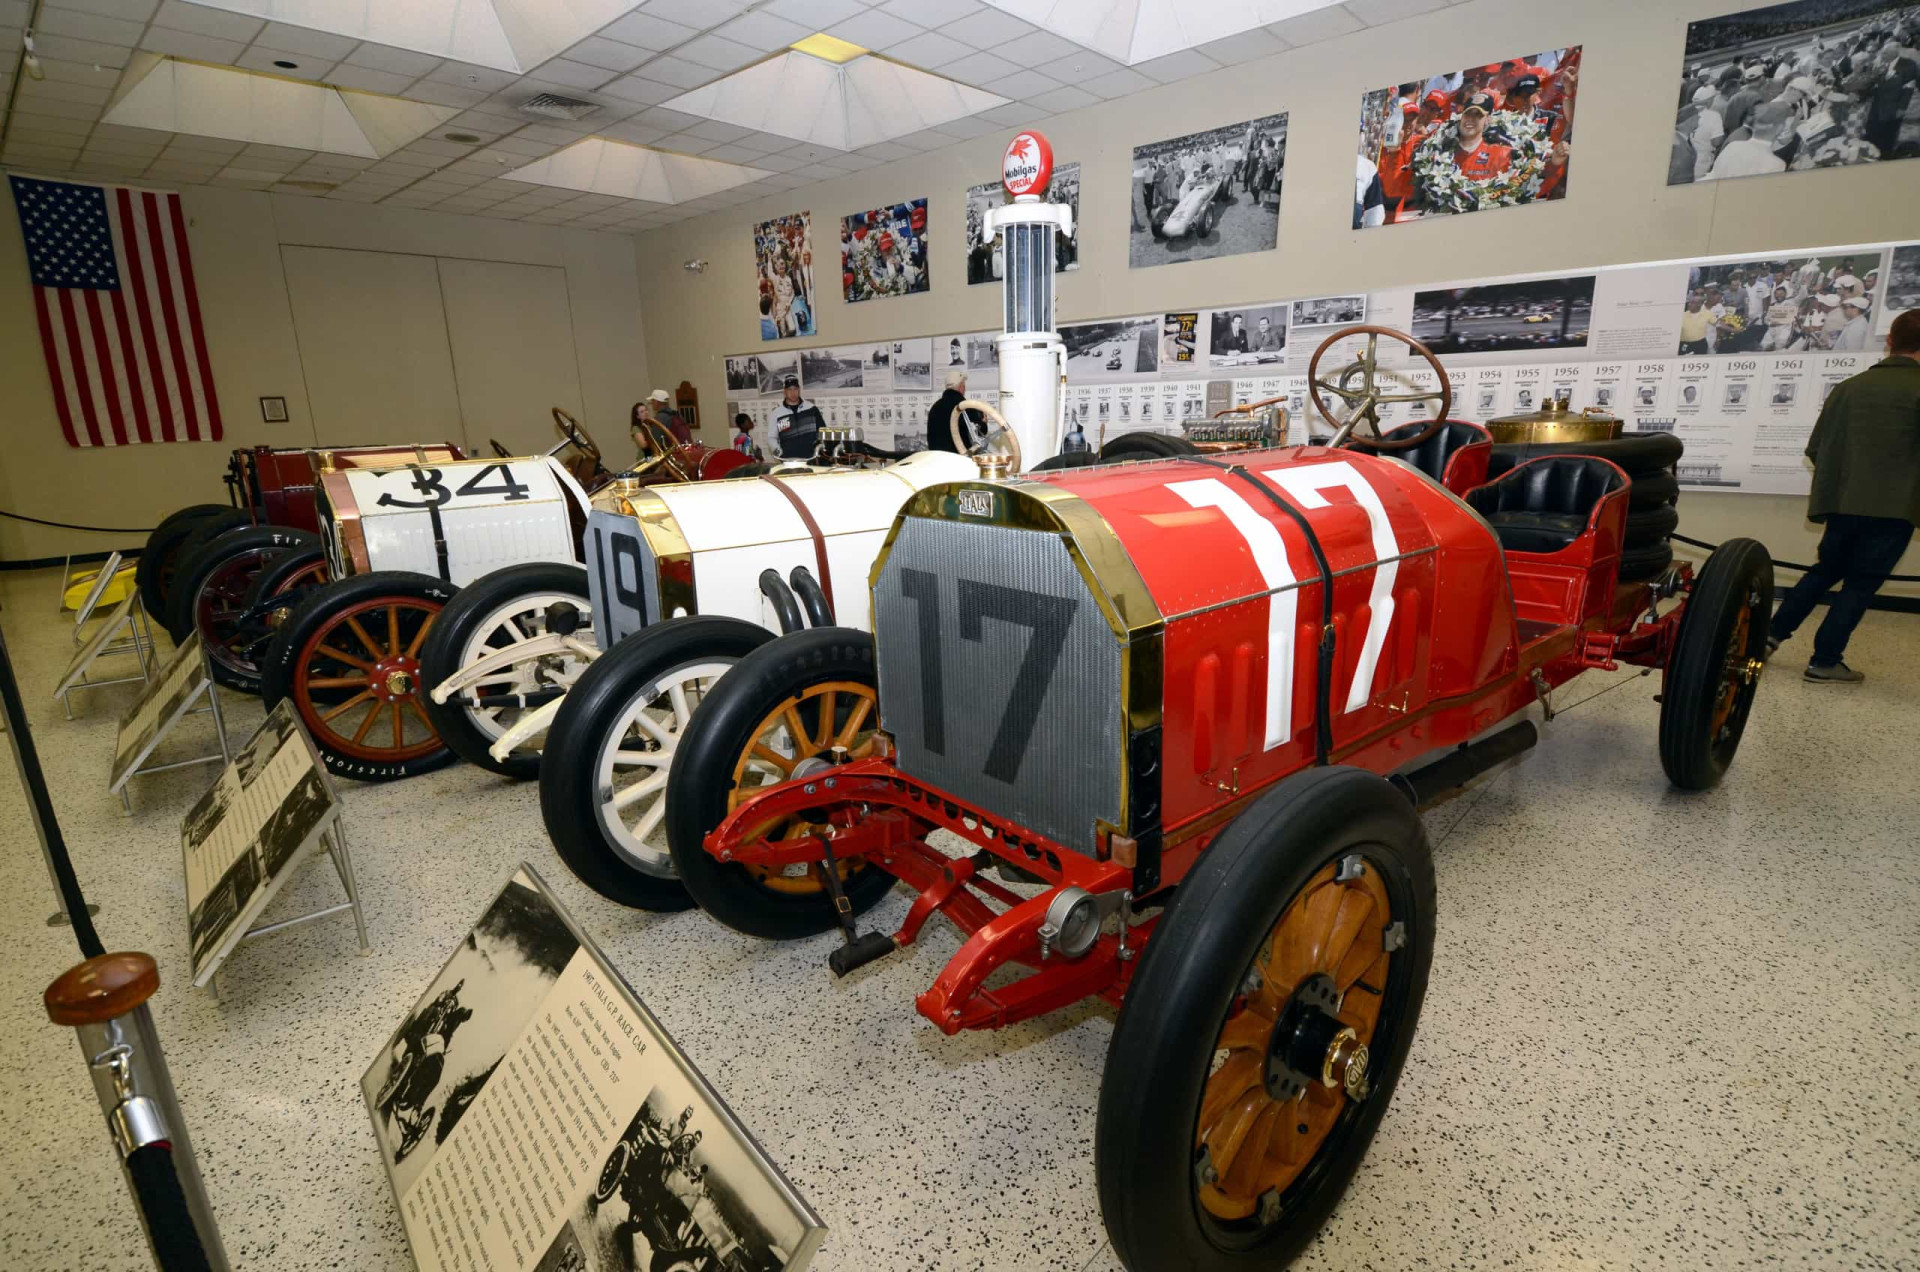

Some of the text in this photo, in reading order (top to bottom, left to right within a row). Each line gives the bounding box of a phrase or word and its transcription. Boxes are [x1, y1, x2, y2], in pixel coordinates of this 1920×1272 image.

[1005, 165, 1036, 178] Mobilgas
[1010, 177, 1032, 190] SPECIAL
[1681, 362, 1710, 373] 1959
[1727, 360, 1756, 371] 1960
[1775, 358, 1804, 370] 1961
[1824, 357, 1856, 368] 1962
[1480, 370, 1502, 379] 1954
[1516, 369, 1540, 378] 1955
[1554, 368, 1579, 376] 1956
[1596, 366, 1622, 375] 1957
[1638, 364, 1665, 374] 1958
[1379, 375, 1398, 383] 1951
[1411, 373, 1432, 382] 1952
[1449, 372, 1466, 380] 953
[1290, 379, 1308, 387] 1948
[376, 463, 530, 508] 34
[1163, 460, 1400, 752] 17
[902, 566, 1080, 785] 17
[320, 750, 407, 776] Fireston
[591, 981, 607, 1005] ITALA
[616, 1014, 634, 1038] RACE
[632, 1034, 646, 1055] CAR
